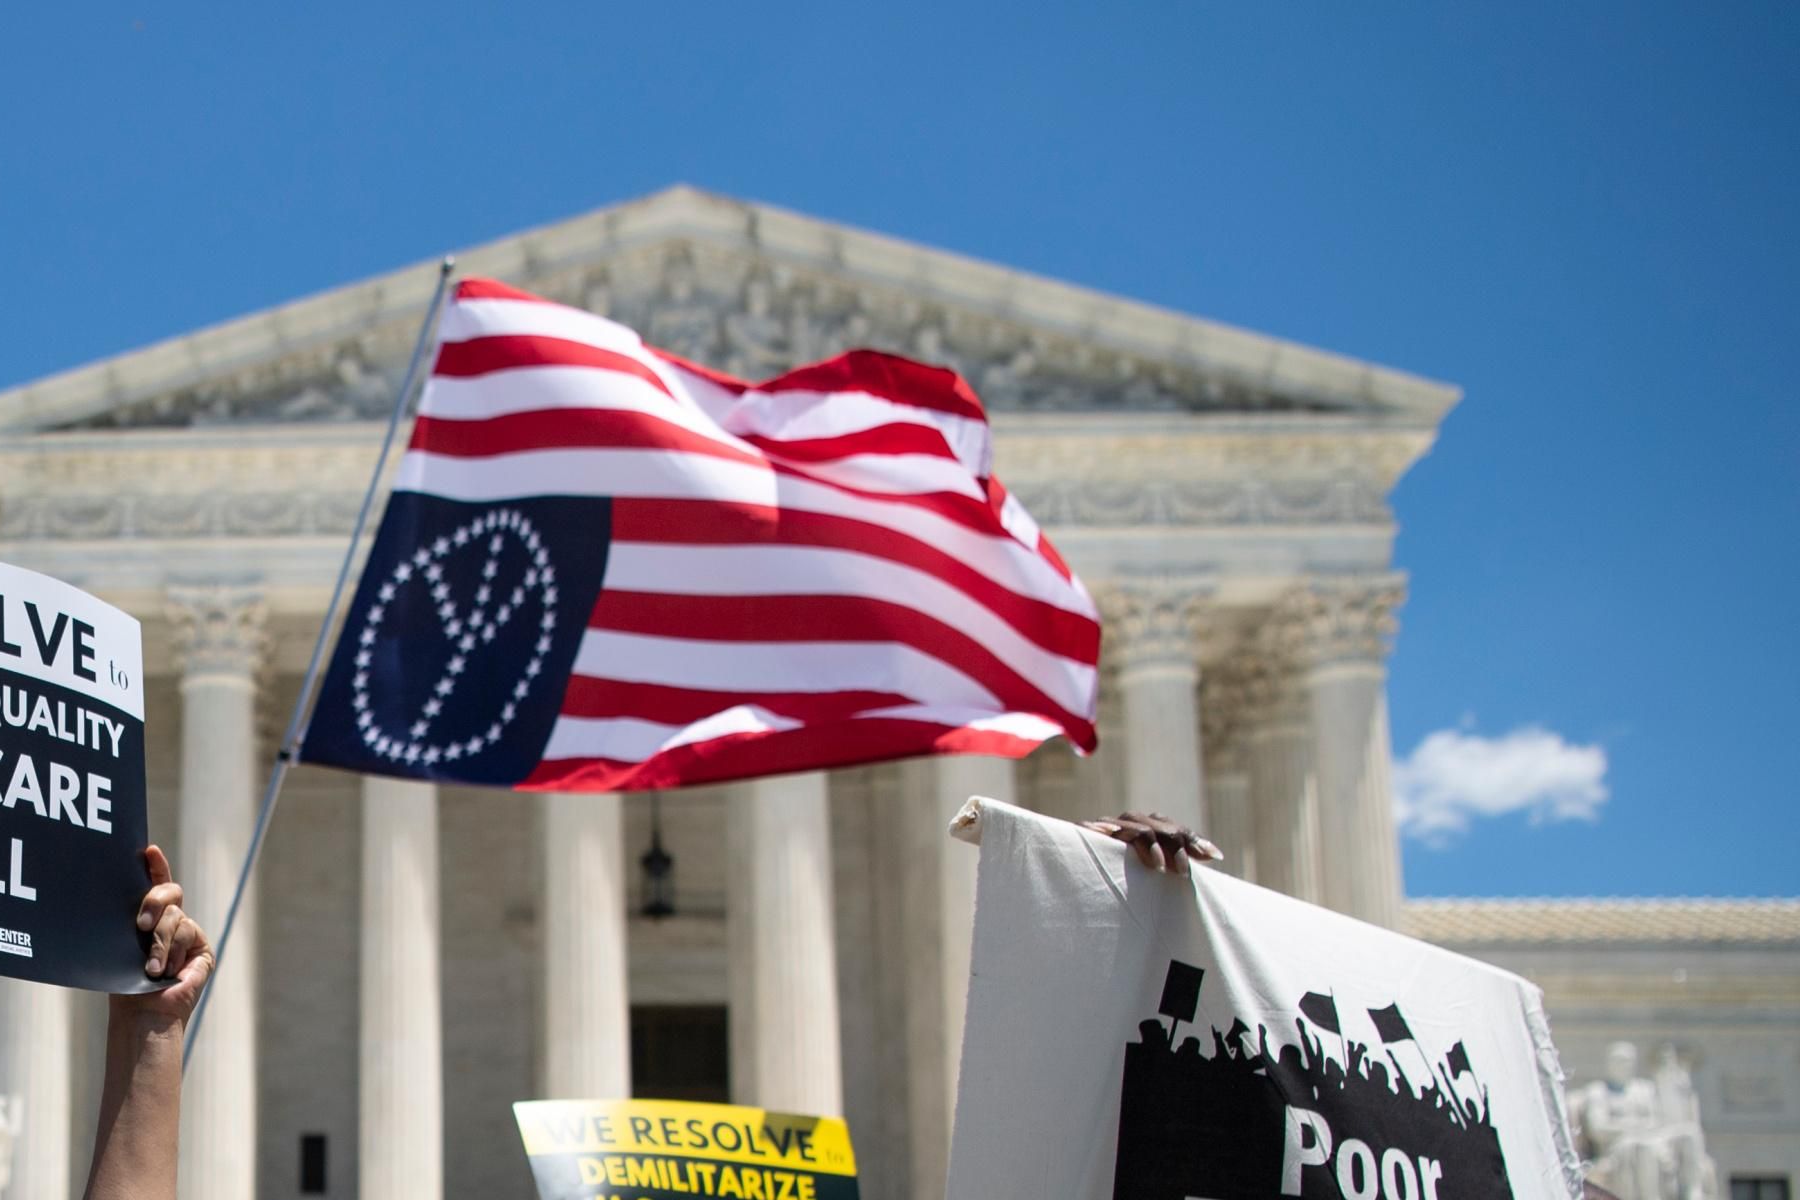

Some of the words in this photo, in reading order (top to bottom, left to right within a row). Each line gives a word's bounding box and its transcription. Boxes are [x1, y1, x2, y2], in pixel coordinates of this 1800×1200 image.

[107, 659, 129, 692] to
[543, 1115, 617, 1145] WE
[629, 1115, 818, 1163] RESOLVE
